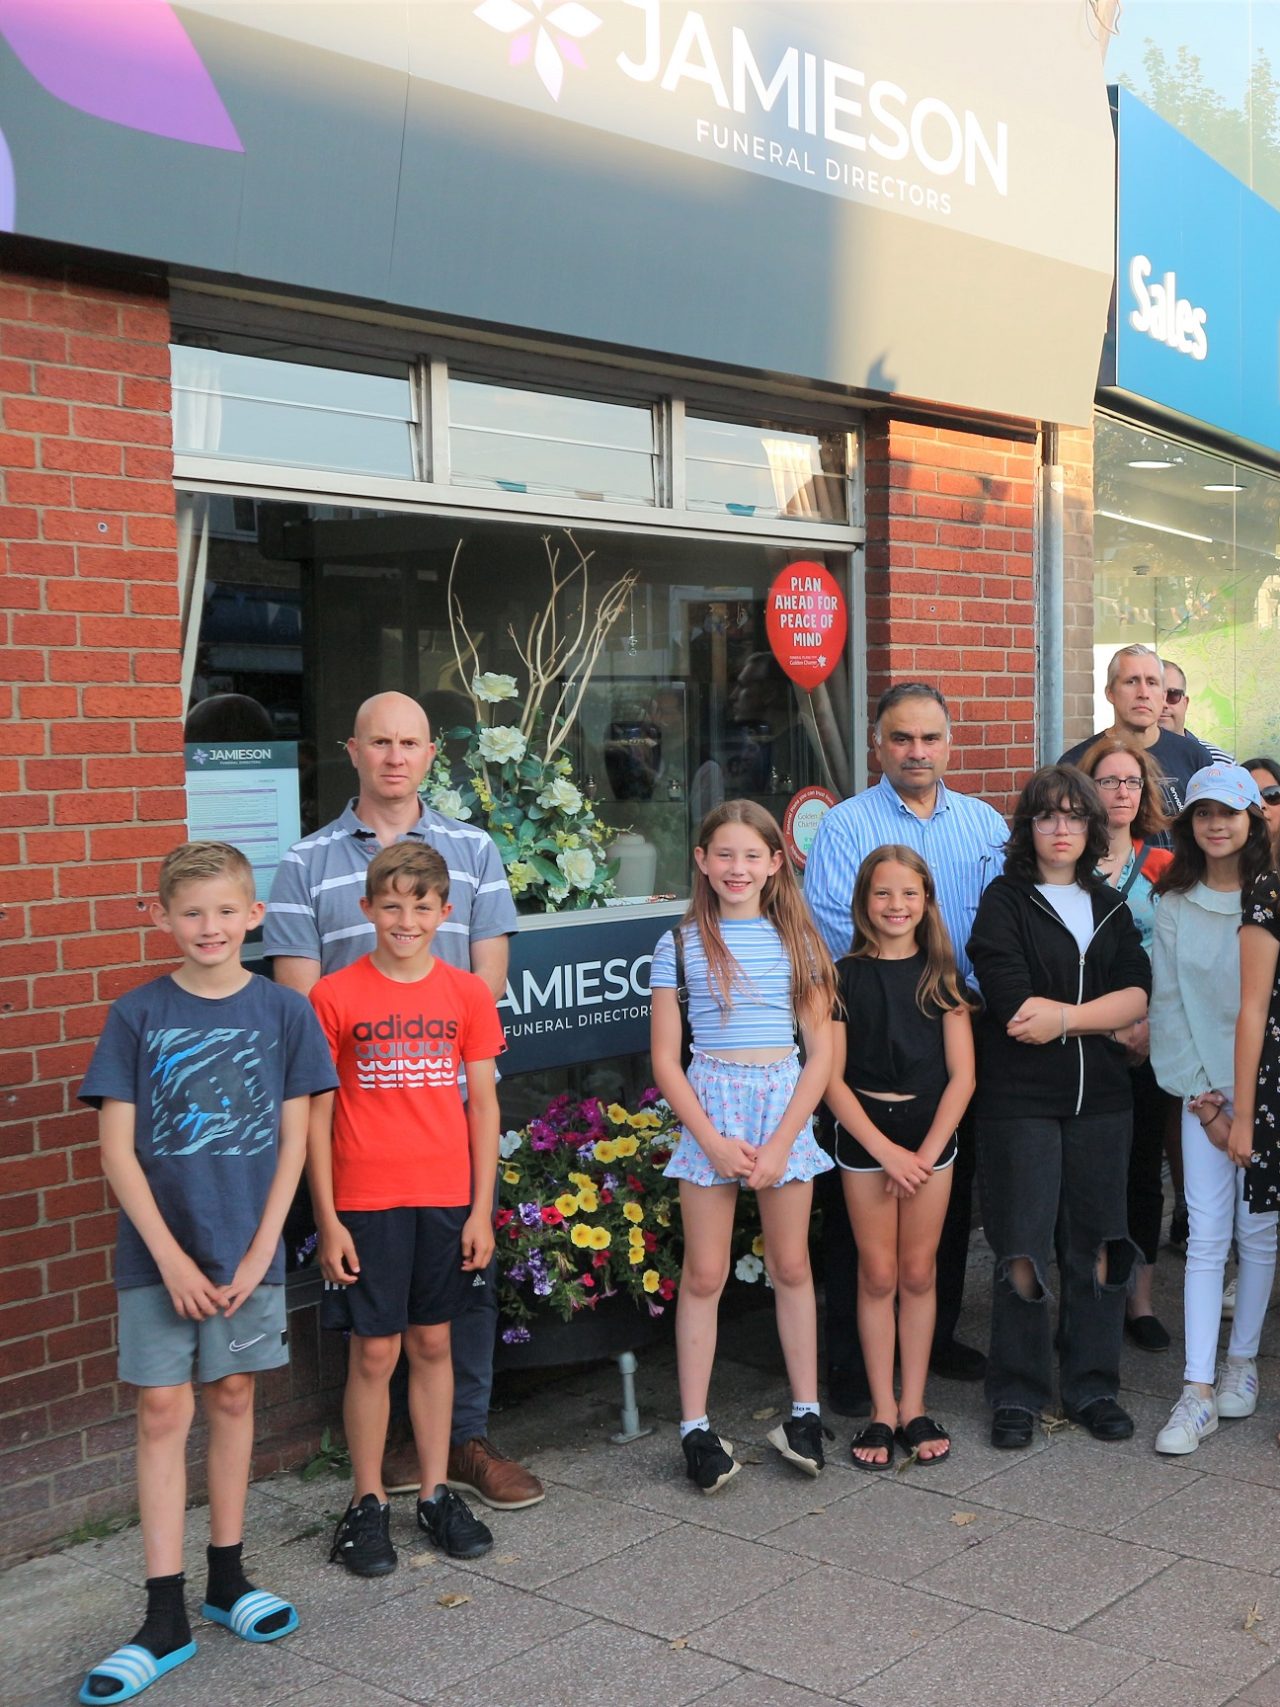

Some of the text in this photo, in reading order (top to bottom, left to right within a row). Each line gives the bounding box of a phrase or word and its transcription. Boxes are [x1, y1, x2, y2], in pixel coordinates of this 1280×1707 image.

[616, 0, 1008, 196] JAMIESON
[696, 118, 952, 215] FUNERAL DIRECTORS
[1130, 254, 1207, 361] Sales
[791, 577, 822, 591] PLAN
[775, 595, 838, 611] AHEAD FOR
[780, 614, 834, 629] PEACE OF
[793, 632, 822, 647] MIND
[209, 749, 272, 760] JAMIESON
[496, 955, 653, 1015] AMIESO
[352, 1014, 458, 1042] adidas
[503, 1017, 573, 1038] FUNERAL
